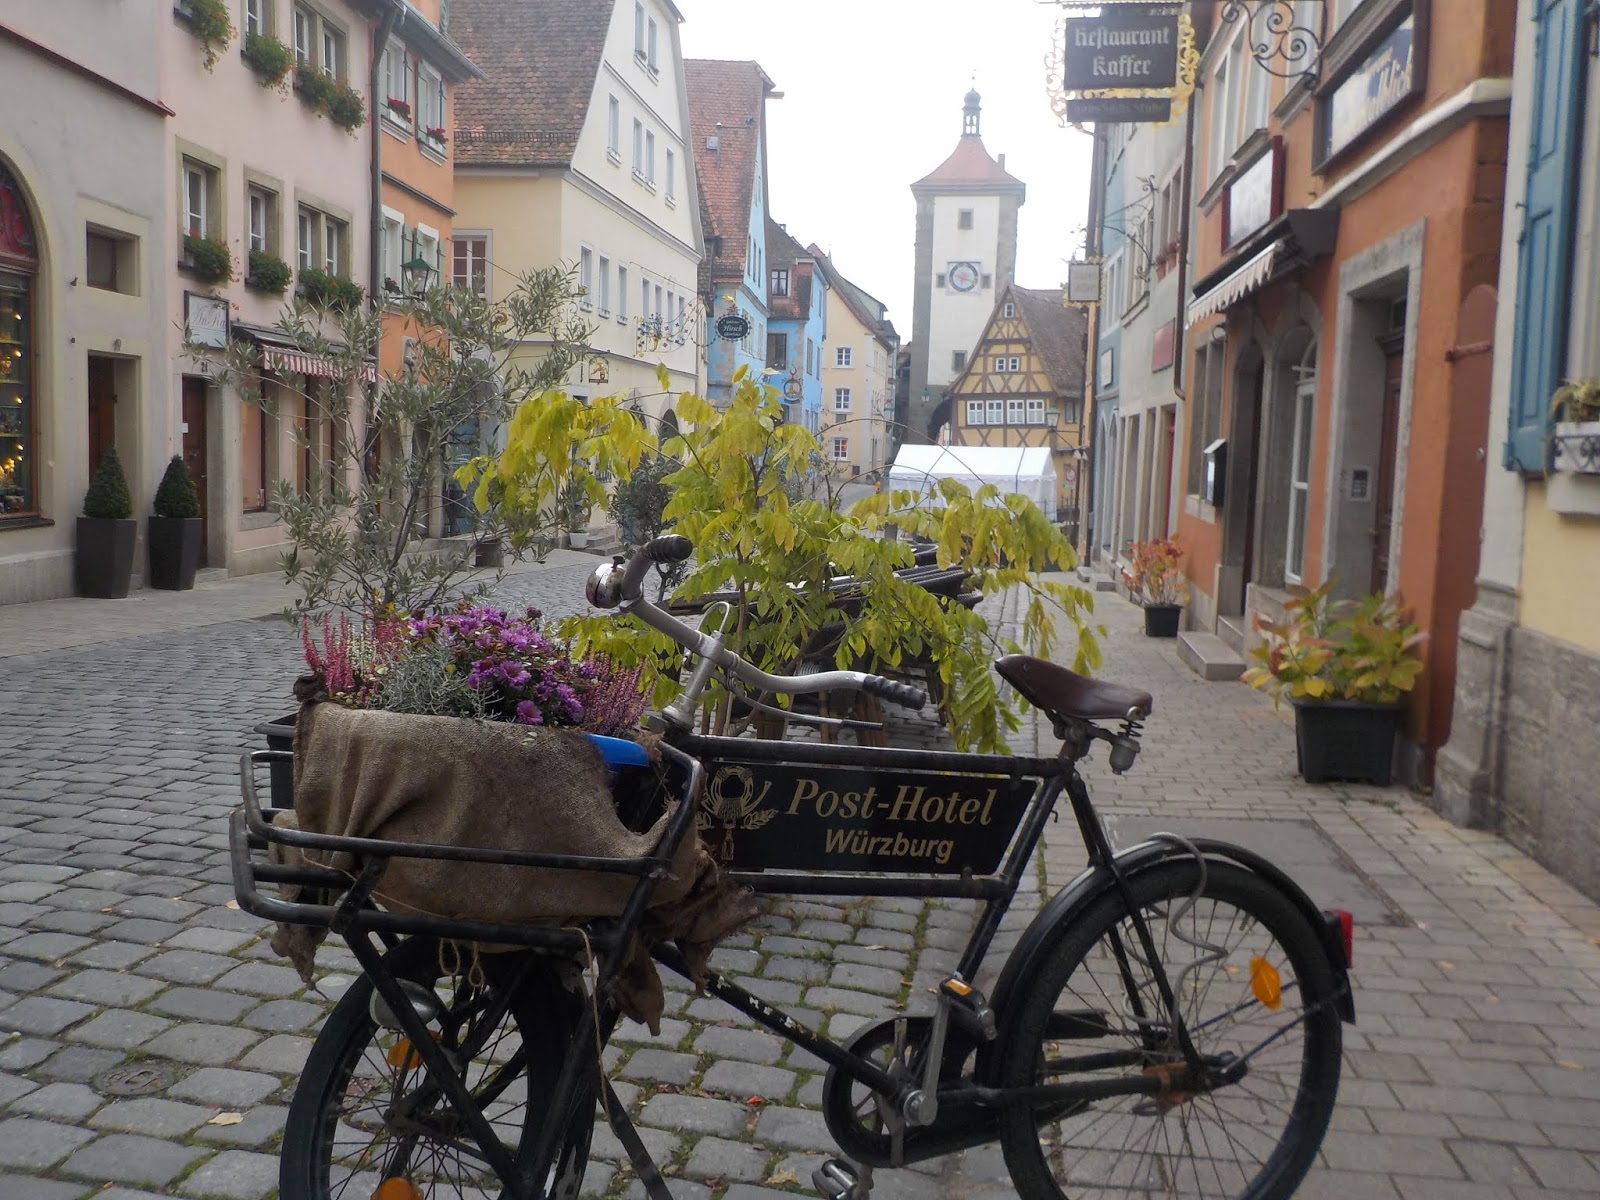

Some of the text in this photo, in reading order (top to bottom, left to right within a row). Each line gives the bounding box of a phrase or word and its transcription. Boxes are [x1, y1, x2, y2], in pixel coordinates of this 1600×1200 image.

[1074, 26, 1169, 49] Restaurant
[1093, 55, 1152, 77] Kaffee
[786, 779, 996, 826] Post-Hotel
[825, 829, 954, 864] Würzburg
